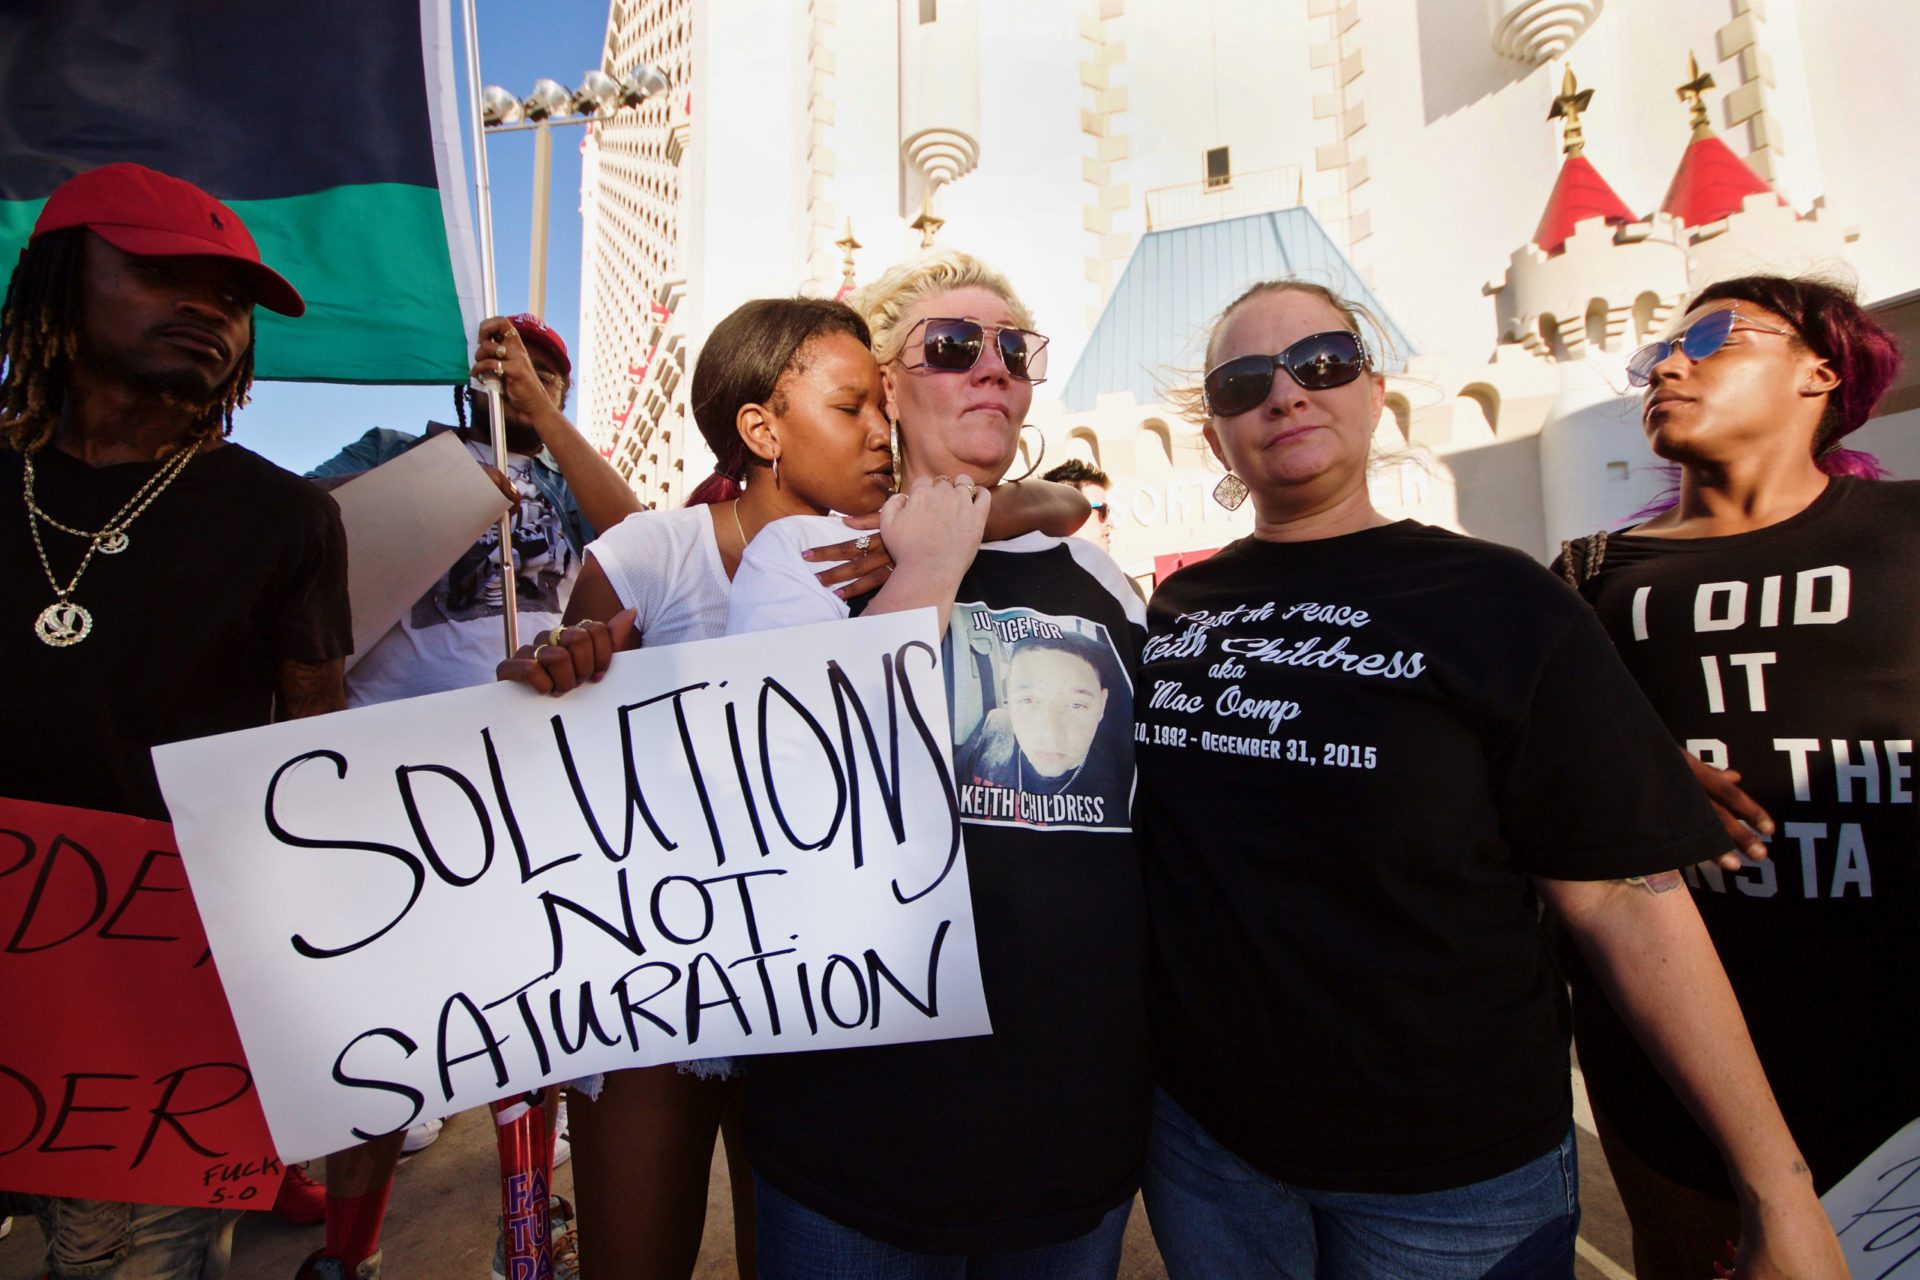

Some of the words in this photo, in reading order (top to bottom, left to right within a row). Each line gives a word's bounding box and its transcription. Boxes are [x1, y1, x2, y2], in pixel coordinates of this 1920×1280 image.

[1282, 602, 1371, 628] Peace
[1632, 586, 1652, 641] I
[1694, 565, 1850, 632] DID
[972, 611, 1029, 642] JUTICE
[1030, 618, 1064, 640] FOR
[1208, 656, 1246, 679] aka
[1221, 636, 1426, 679] Childress
[1150, 680, 1204, 713] Mac
[1700, 652, 1776, 713] IT
[1154, 725, 1187, 748] 1992
[1202, 731, 1281, 760] DECEMBER
[1286, 739, 1317, 766] 31,
[1323, 743, 1377, 769] 2015
[1773, 738, 1913, 803] THE
[265, 640, 962, 958] SOLUTIONS
[960, 784, 1015, 818] KEITH
[1020, 791, 1105, 823] CHILDRESS
[537, 868, 786, 975] NOT
[333, 920, 951, 1140] SATURATION
[203, 1156, 280, 1187] FUCK
